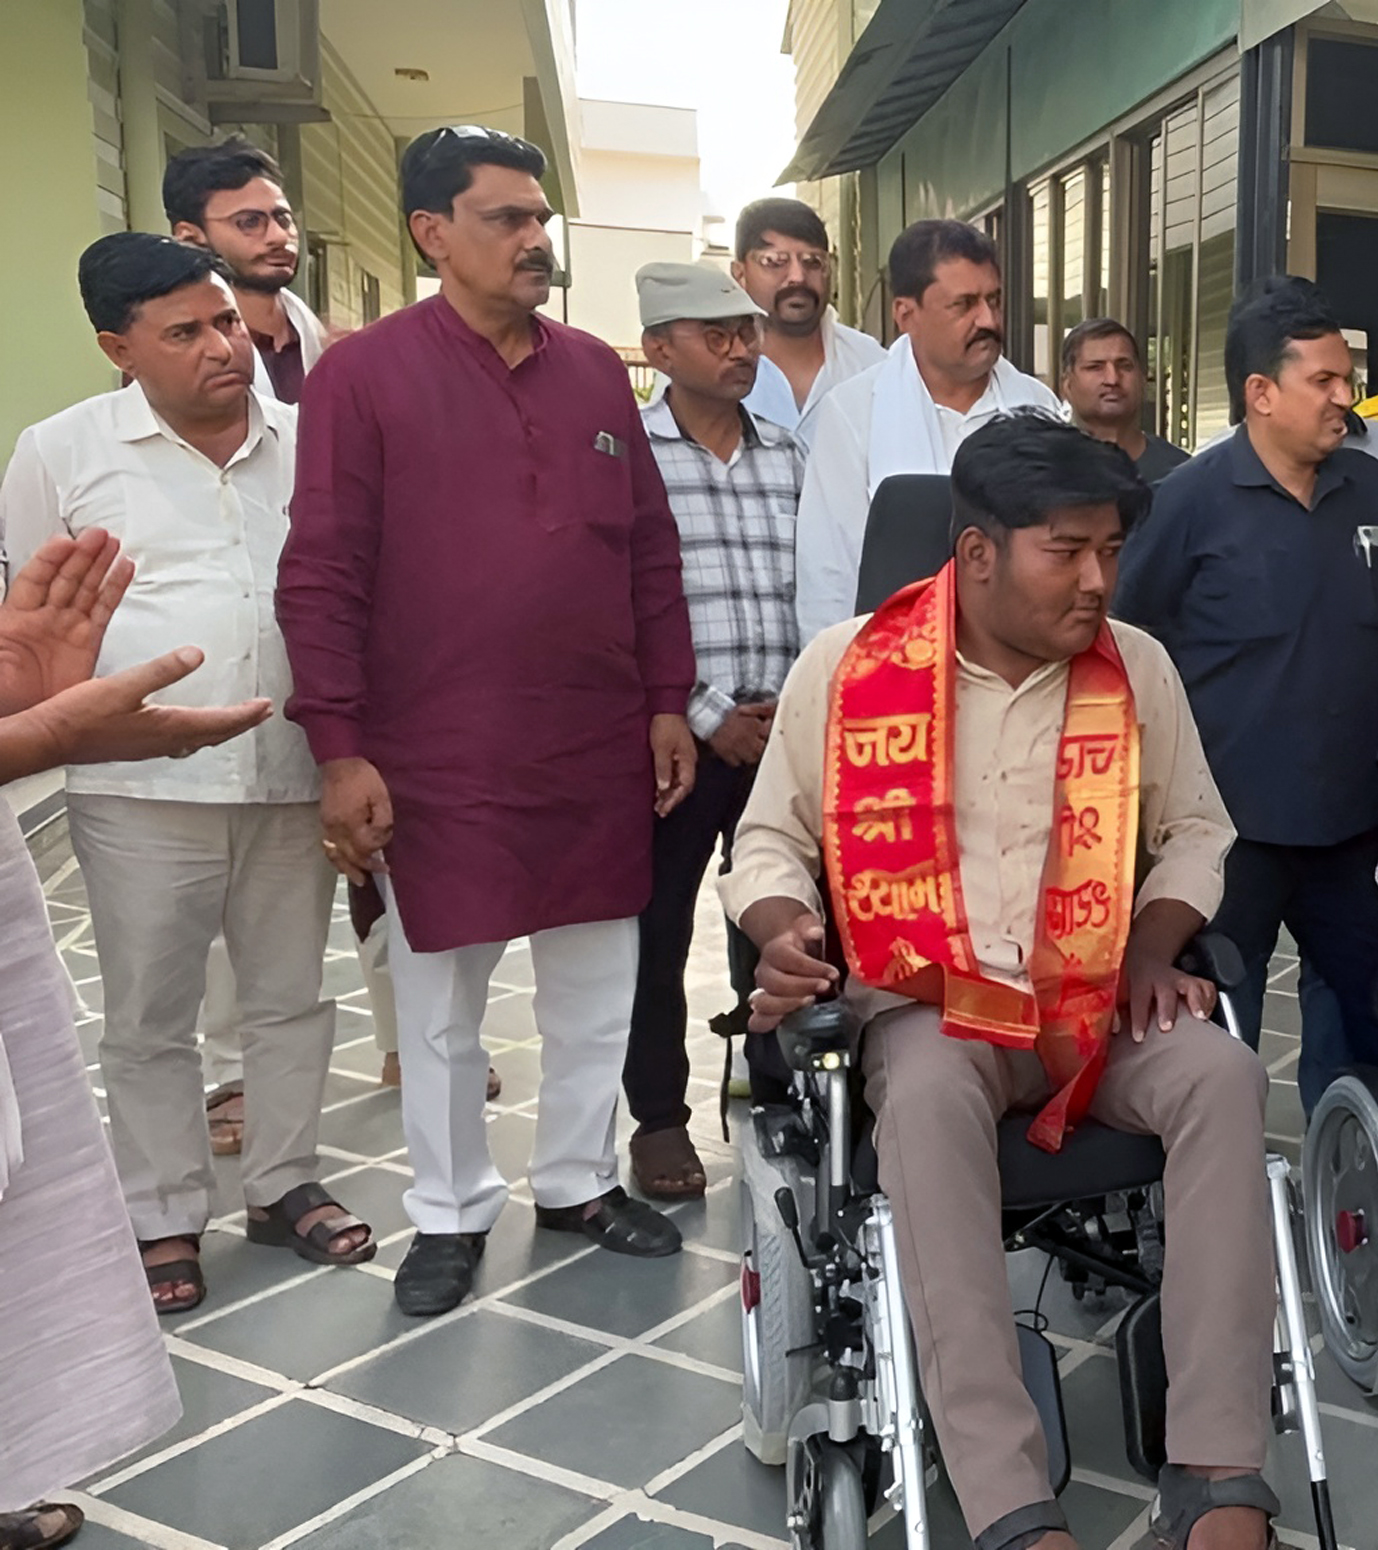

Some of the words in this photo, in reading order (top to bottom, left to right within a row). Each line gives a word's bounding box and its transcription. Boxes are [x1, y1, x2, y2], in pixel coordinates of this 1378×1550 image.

[843, 713, 932, 767] जय
[851, 788, 916, 843] श्री
[846, 860, 941, 922] श्याम
